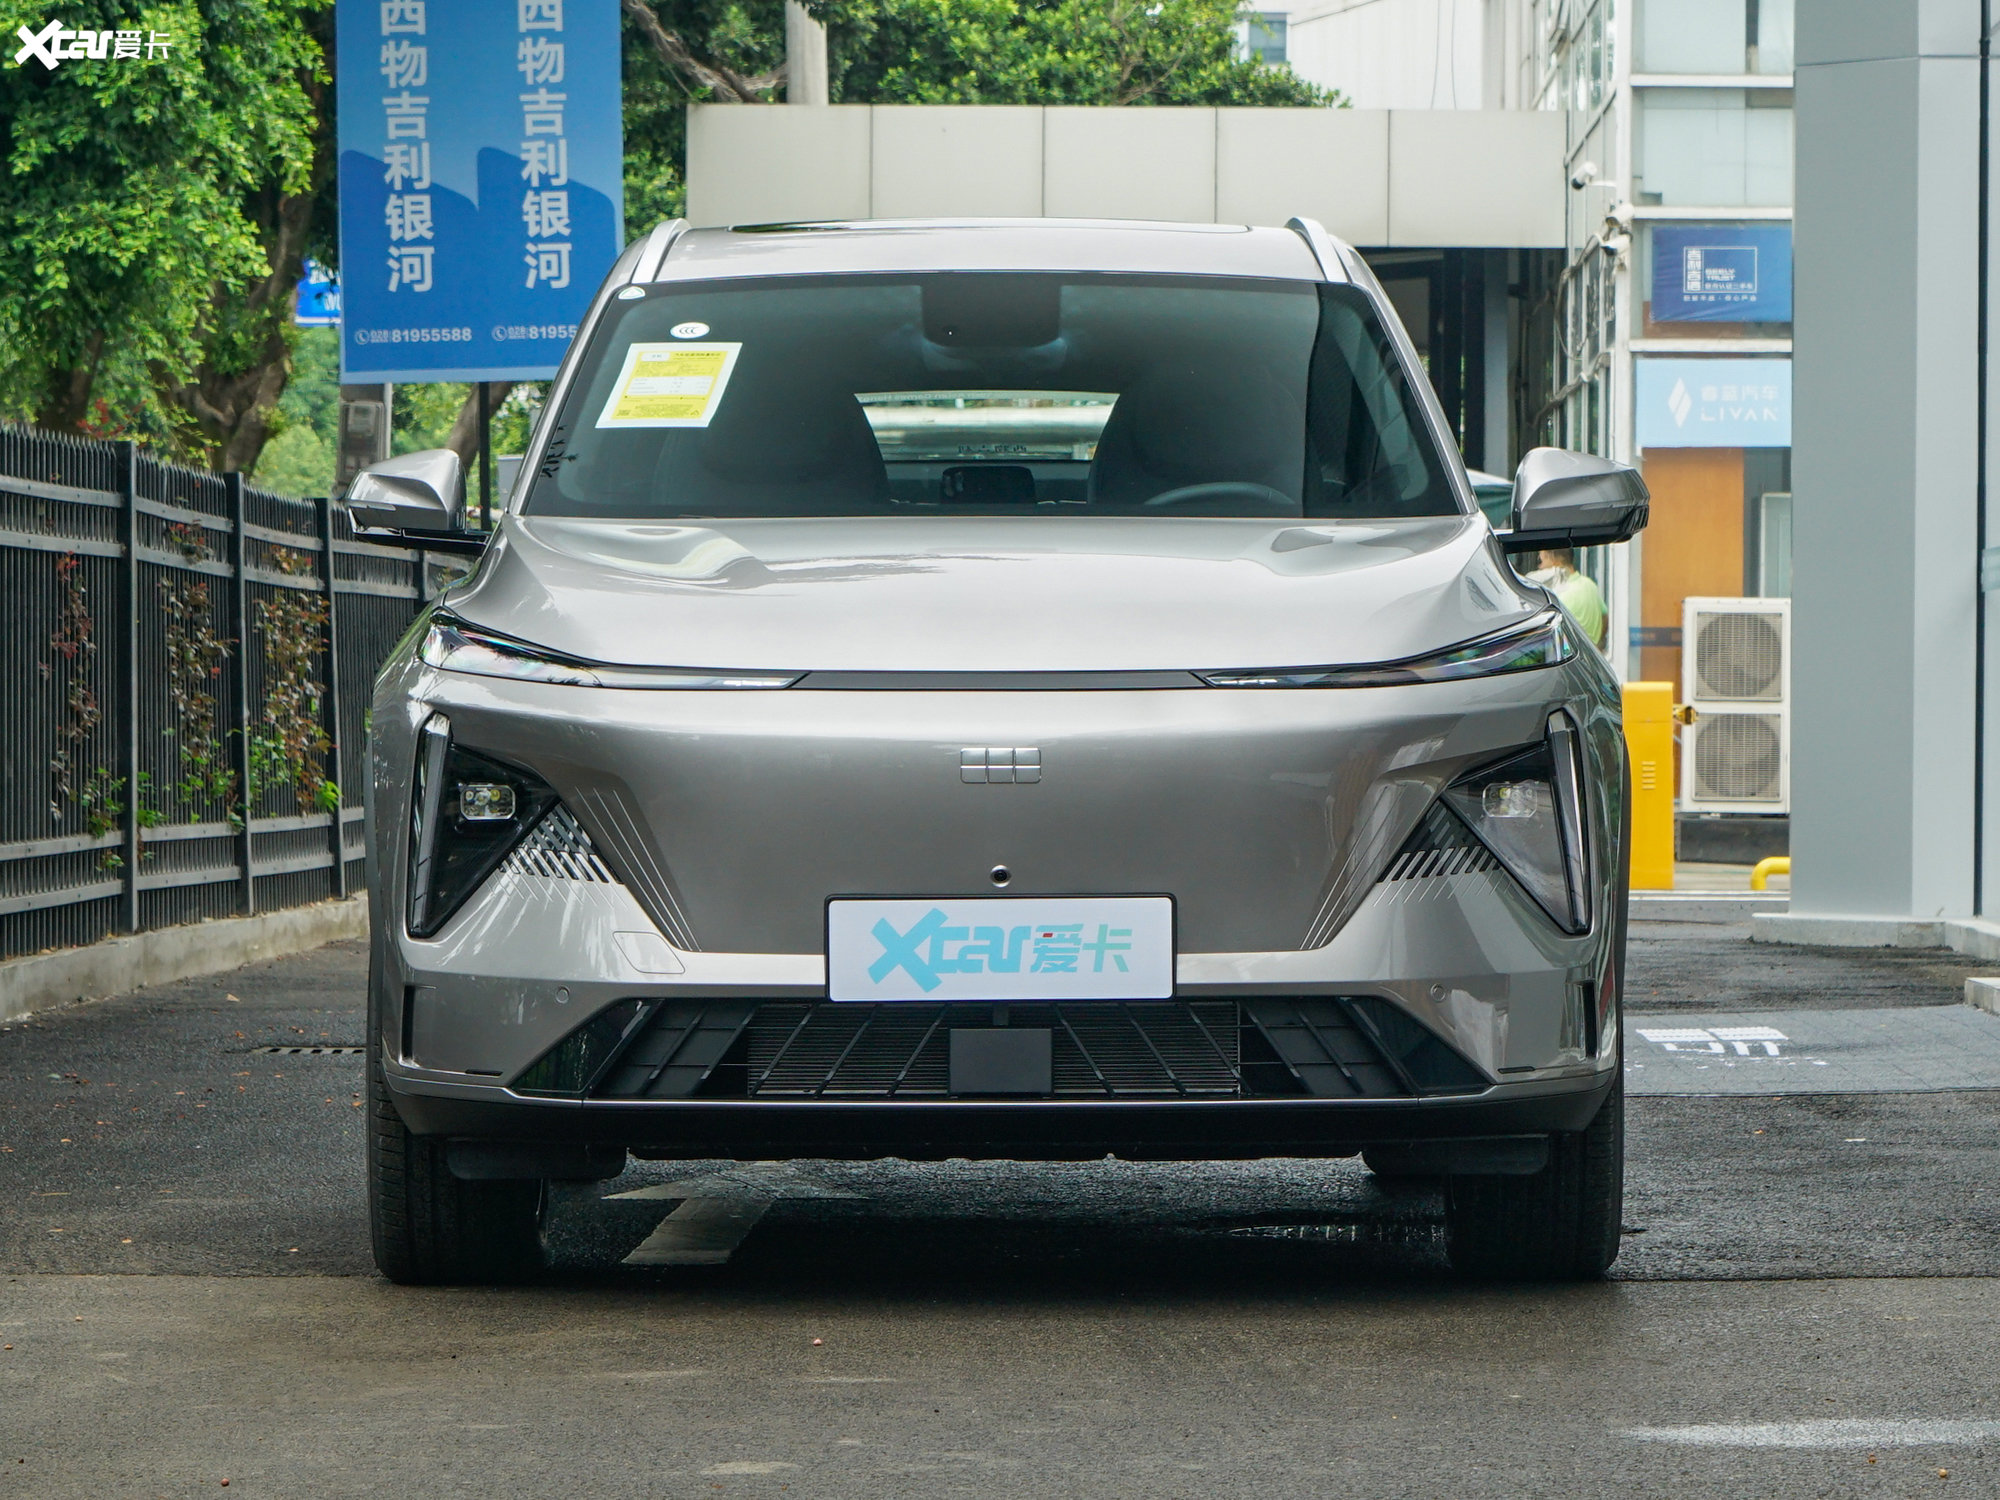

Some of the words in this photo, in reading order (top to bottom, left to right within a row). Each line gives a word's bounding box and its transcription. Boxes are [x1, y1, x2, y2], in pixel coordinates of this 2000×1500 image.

[380, 0, 435, 293] 西物吉利银河
[517, 0, 573, 289] 西物吉利银河
[391, 327, 472, 343] 81955588
[1701, 407, 1778, 422] LIVAN
